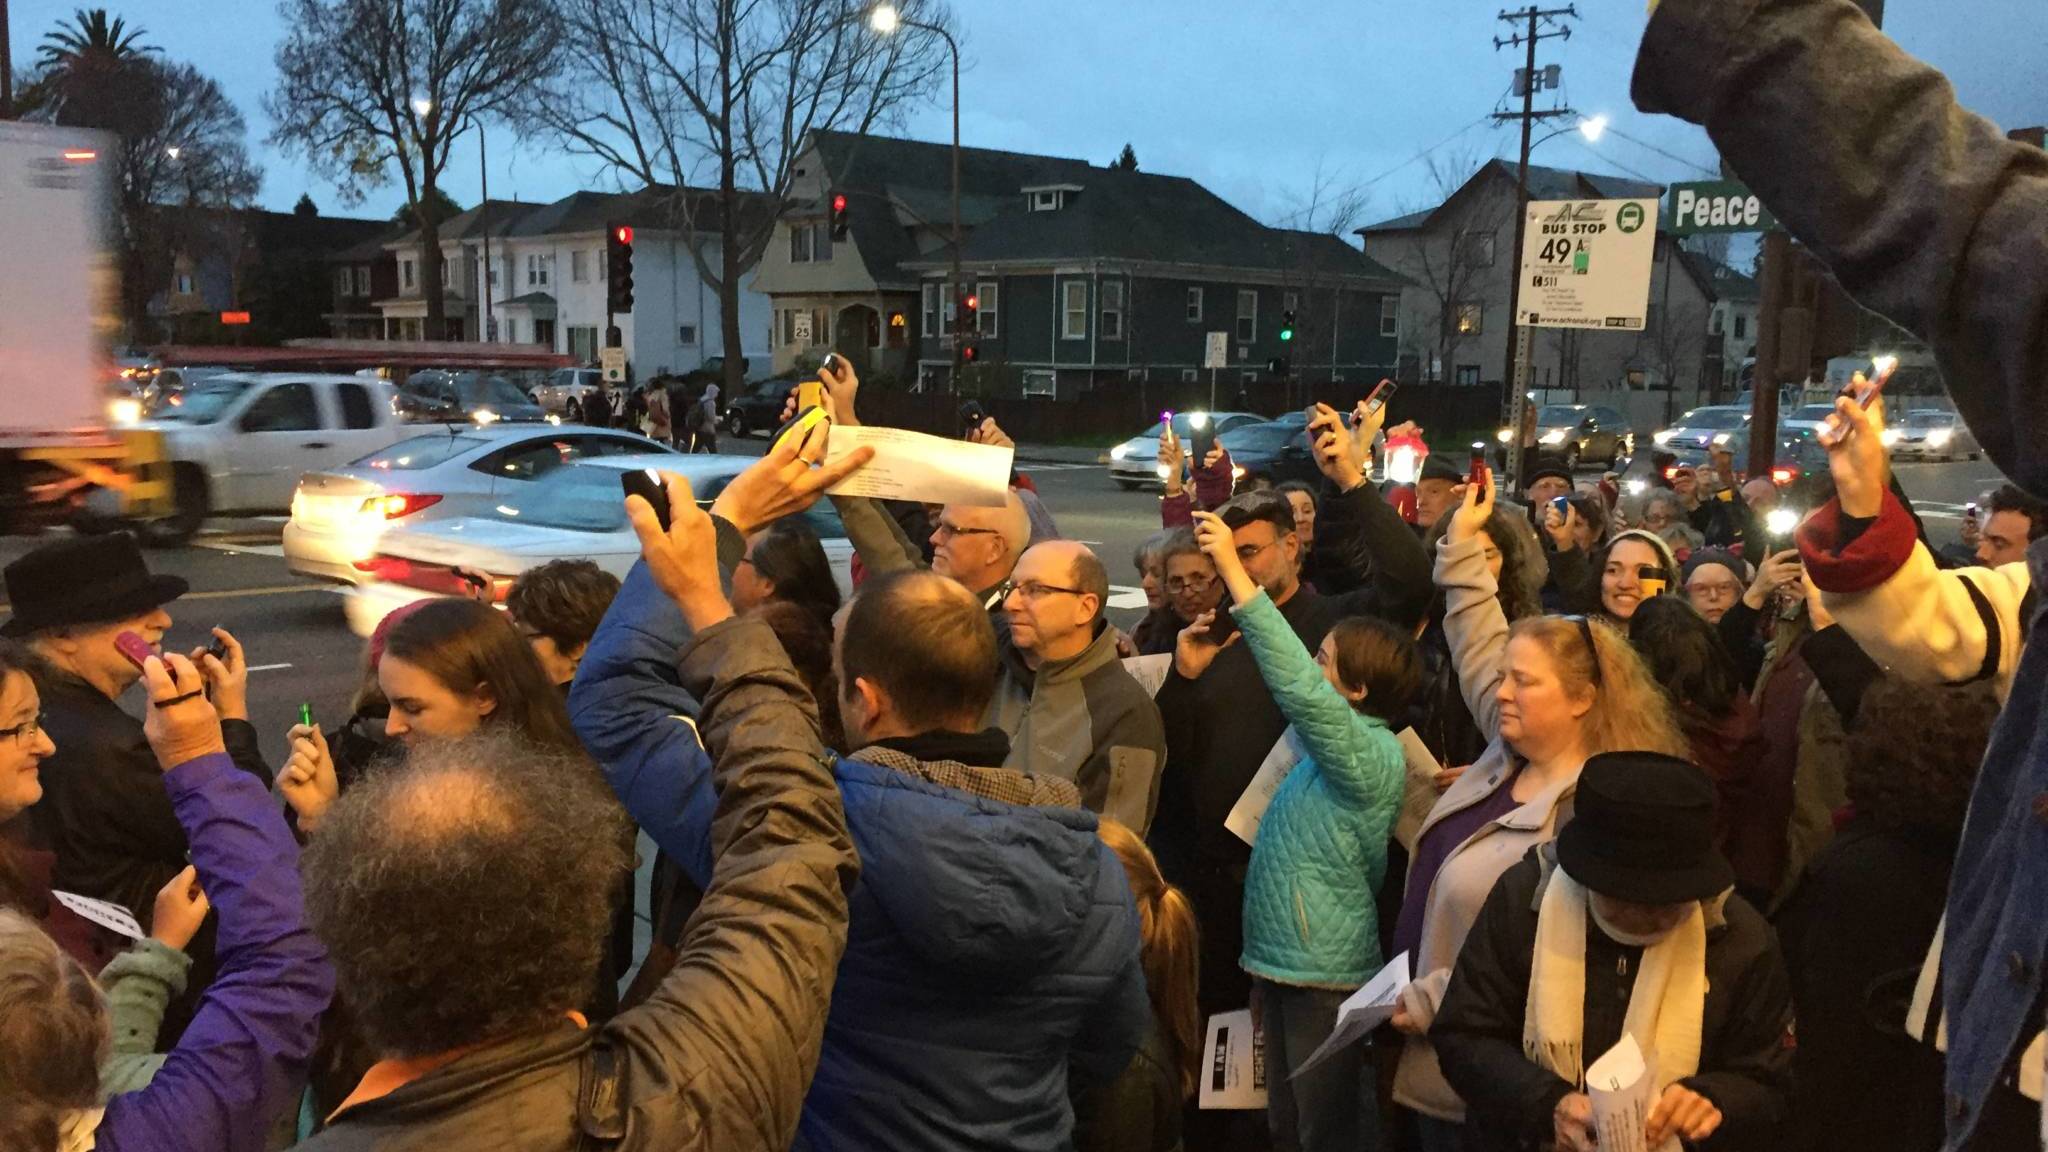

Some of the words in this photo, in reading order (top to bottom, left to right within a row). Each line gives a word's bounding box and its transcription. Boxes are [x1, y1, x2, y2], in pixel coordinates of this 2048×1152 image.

[1676, 189, 1760, 227] Peace
[1542, 223, 1567, 234] BUS
[1572, 223, 1607, 234] STOP
[1540, 238, 1571, 263] 49
[1543, 277, 1557, 287] 511
[796, 327, 809, 337] 25
